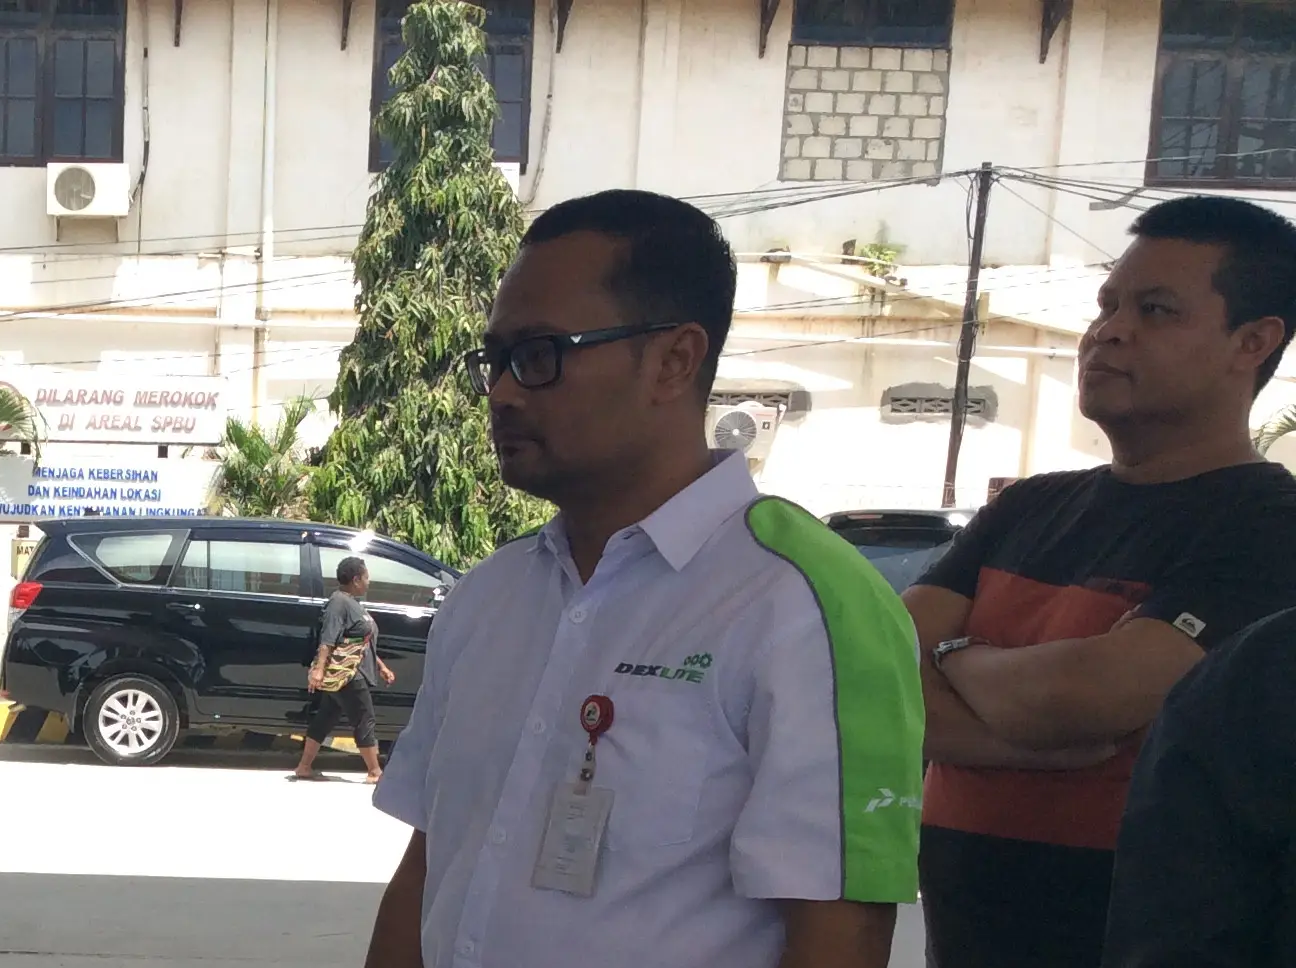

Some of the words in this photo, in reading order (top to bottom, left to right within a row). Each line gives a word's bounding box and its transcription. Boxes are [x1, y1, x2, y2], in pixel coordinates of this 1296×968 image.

[35, 388, 124, 407] DILARANG
[134, 390, 219, 410] MEROKOK
[58, 413, 75, 431] DI
[85, 414, 141, 432] AREAL
[151, 415, 196, 433] SPBU
[33, 467, 85, 480] MENJAGA
[88, 468, 158, 482] KEBERSIHAN
[28, 485, 49, 497] DAN
[54, 486, 117, 500] KEINDAHAN
[120, 488, 161, 501] LOKASI
[614, 662, 704, 684] DEXLITE
